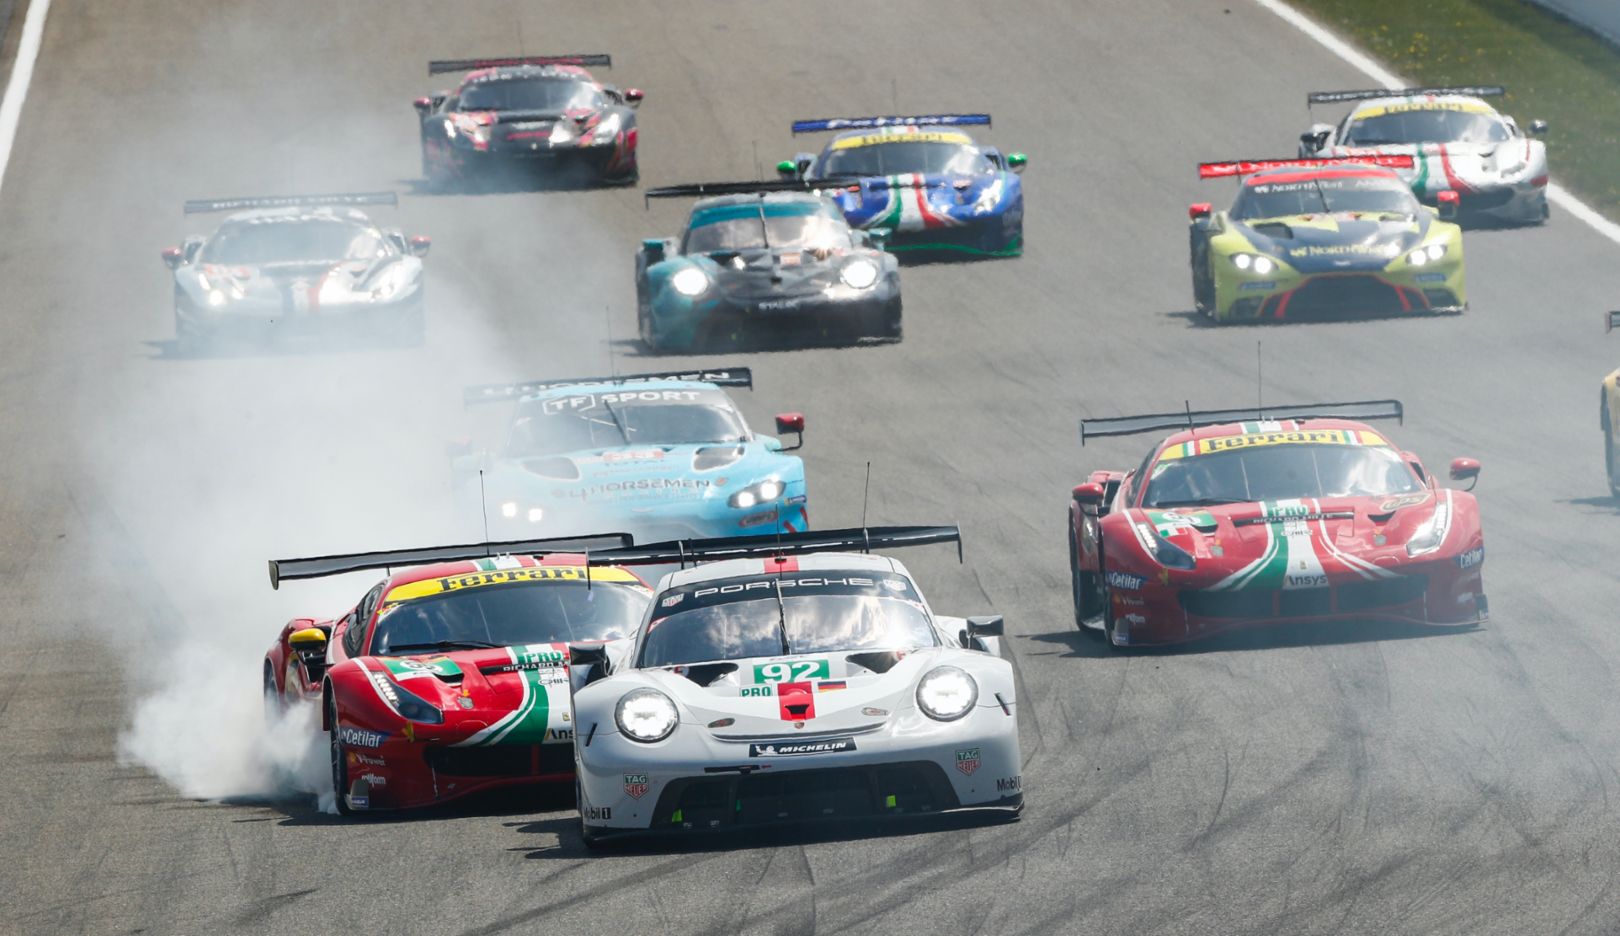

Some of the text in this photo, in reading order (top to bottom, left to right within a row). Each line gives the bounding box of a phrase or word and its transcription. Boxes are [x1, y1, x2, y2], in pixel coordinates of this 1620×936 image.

[550, 391, 700, 410] TF SPORT
[1207, 432, 1337, 452] Ferrari
[437, 569, 586, 591] Ferrari
[1111, 572, 1141, 590] Cetilar
[1284, 574, 1327, 586] Ansys
[695, 578, 874, 598] PORSCHE
[525, 651, 562, 663] PRO
[503, 661, 555, 671] RICHARD
[762, 661, 822, 683] 92
[741, 686, 771, 697] PRO
[346, 729, 381, 748] Cetilar
[544, 728, 574, 740] Ans
[779, 742, 846, 753] MICHELIN
[958, 751, 978, 760] TAG
[625, 775, 646, 783] TAG
